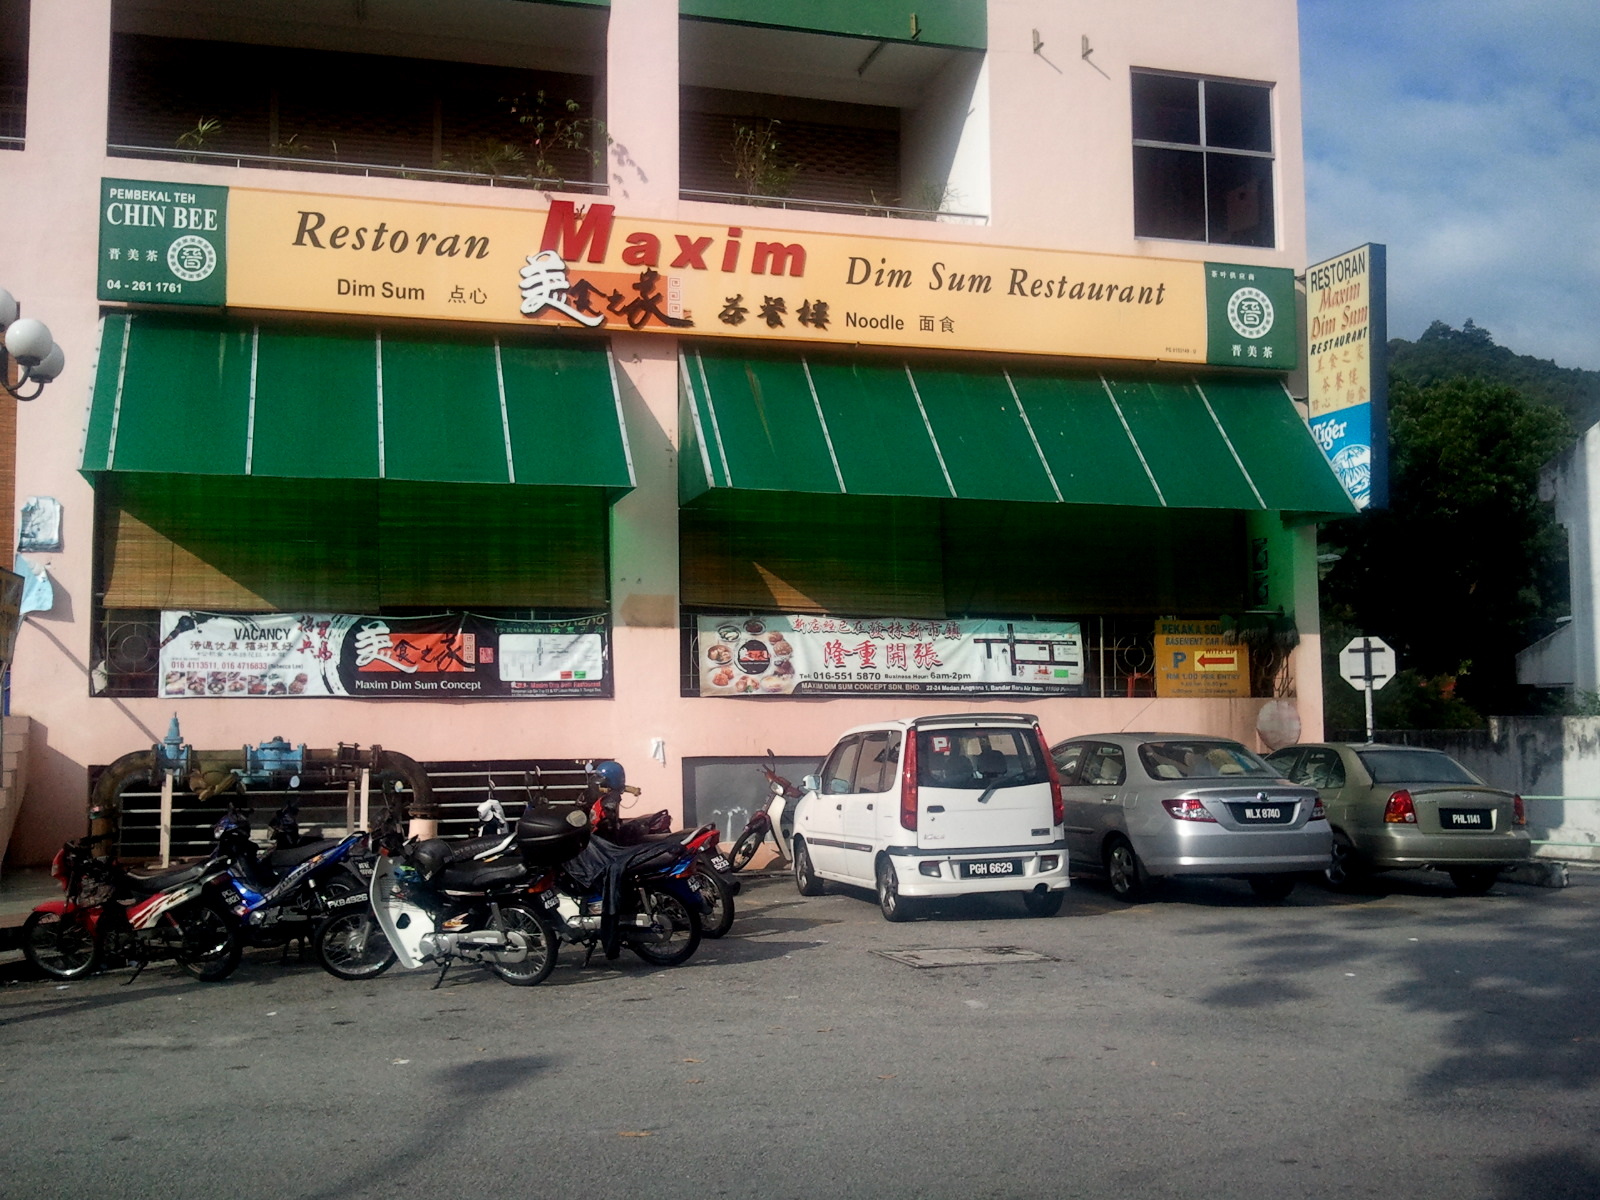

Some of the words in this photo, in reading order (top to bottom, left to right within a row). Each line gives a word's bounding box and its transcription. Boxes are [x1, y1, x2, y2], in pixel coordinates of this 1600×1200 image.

[110, 188, 171, 202] PEMBEKAL
[174, 192, 195, 204] TEH
[107, 202, 167, 227] CHIN
[172, 206, 218, 231] BEE
[292, 210, 491, 259] Restoran
[540, 199, 807, 277] Maxim
[846, 256, 912, 289] Dim
[929, 261, 993, 294] Sum
[1007, 267, 1166, 306] Restaurant
[1311, 251, 1366, 293] RESTORAN
[107, 279, 121, 290] 04
[132, 281, 152, 292] 261
[155, 282, 182, 293] 1761
[337, 279, 375, 298] Dim
[381, 281, 425, 300] Sum
[447, 285, 488, 305] 点心
[1319, 280, 1361, 313] Maxim
[846, 312, 905, 332] Noodle
[919, 315, 956, 334] 面食
[1311, 314, 1336, 341] Dim
[1341, 305, 1368, 330] Sum
[1310, 327, 1368, 356] RESTAURANT
[1313, 419, 1347, 450] Tiger
[234, 628, 291, 641] VACANCY
[1206, 637, 1219, 646] CAR
[171, 661, 185, 669] 016
[222, 661, 235, 670] 016
[1173, 652, 1187, 668] P
[813, 672, 853, 680] 016-551
[856, 672, 881, 680] 5870
[930, 671, 972, 680] 6am-2pm
[355, 680, 388, 690] Maxim
[391, 680, 412, 690] Dim
[414, 680, 438, 690] Sum
[440, 680, 482, 691] Concept
[801, 682, 823, 690] MAXIM
[824, 682, 837, 690] DIM
[1245, 808, 1261, 819] WLX
[1261, 808, 1281, 819] 8740
[969, 863, 987, 875] PGH
[989, 862, 1013, 874] 6629
